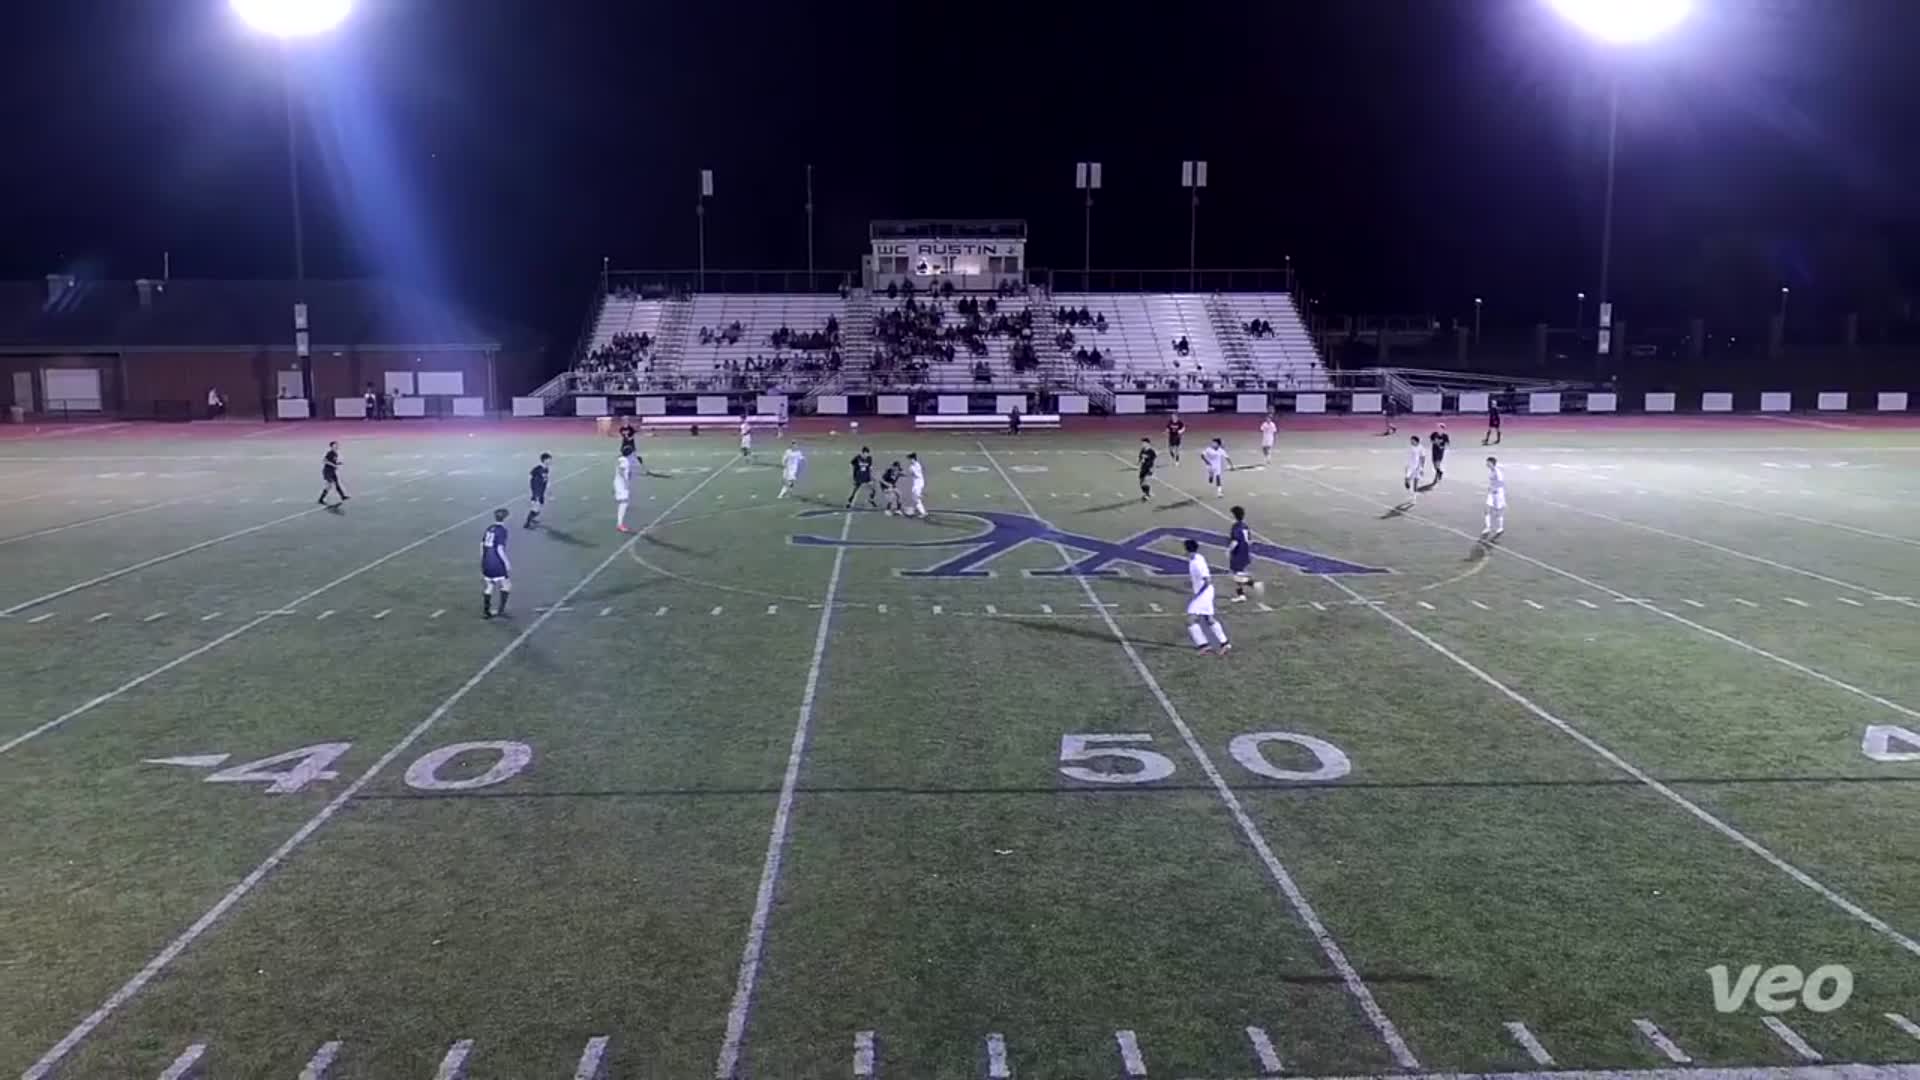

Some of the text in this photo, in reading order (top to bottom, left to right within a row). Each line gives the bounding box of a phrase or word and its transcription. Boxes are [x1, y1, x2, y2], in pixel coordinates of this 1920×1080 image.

[919, 244, 997, 255] AUSTIN
[203, 741, 532, 793] 40
[1059, 732, 1351, 784] 50
